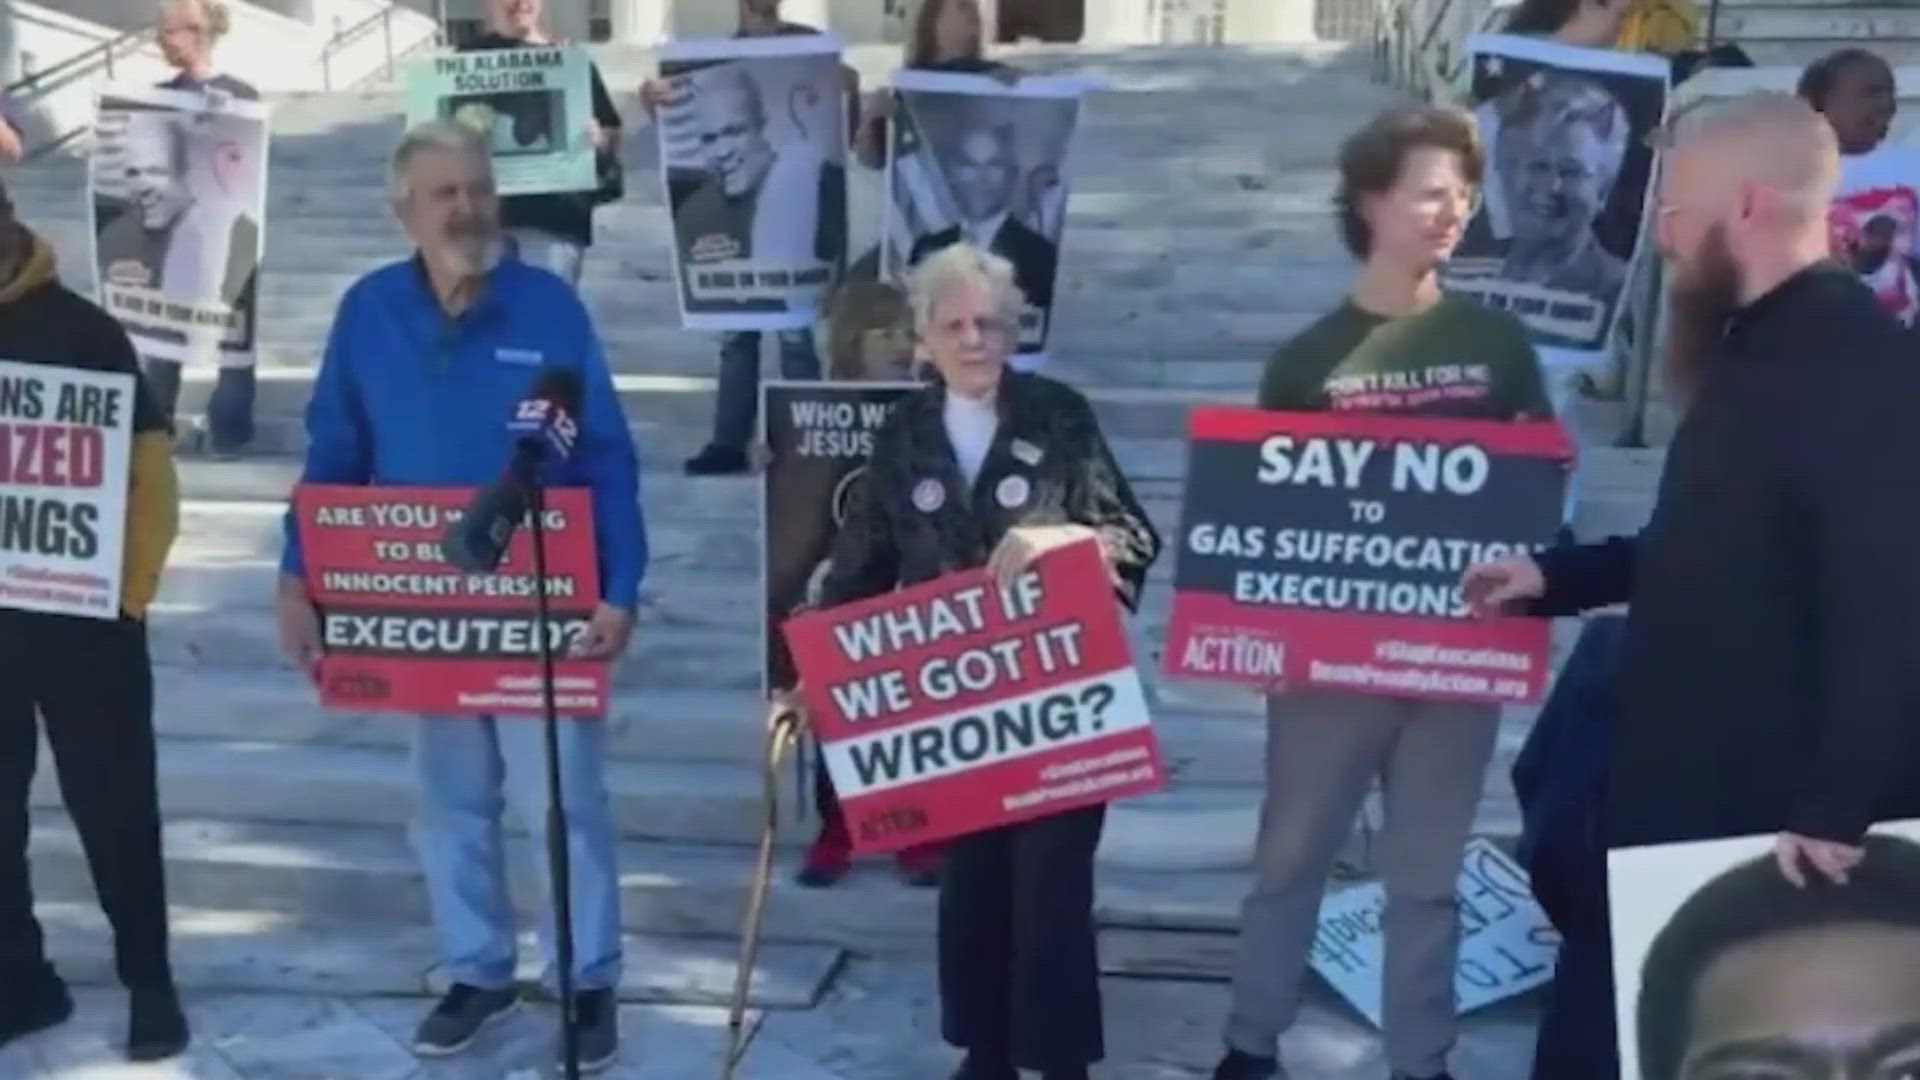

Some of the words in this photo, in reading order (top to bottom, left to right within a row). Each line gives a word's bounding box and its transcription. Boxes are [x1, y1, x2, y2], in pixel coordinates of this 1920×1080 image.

[434, 57, 467, 75] THE
[473, 50, 564, 72] ALABAMA
[455, 71, 544, 91] SOLUTION
[1425, 364, 1461, 386] FOR
[56, 383, 122, 428] ARE
[516, 399, 550, 419] 12
[790, 400, 855, 429] WHO
[860, 401, 897, 429] W
[798, 430, 875, 457] JESUS
[1257, 435, 1376, 489] SAY
[1391, 440, 1490, 496] NO
[0, 496, 98, 559] NGS
[316, 507, 363, 527] ARE
[370, 504, 438, 529] YOU
[1349, 500, 1386, 524] TO
[374, 540, 410, 561] TO
[1189, 525, 1266, 559] GAS
[1274, 528, 1547, 572] SUFFOCATI
[323, 571, 460, 595] INNOCENT
[1235, 571, 1472, 618] EXECUTIONS
[834, 587, 984, 663] WHAT
[1000, 571, 1042, 621] IF
[325, 615, 589, 653] EXECUTED?
[1180, 633, 1286, 677] ACTION
[832, 669, 912, 723] WE
[919, 638, 1022, 701] GOT
[1035, 622, 1082, 672] IT
[849, 683, 1116, 787] WRONG?
